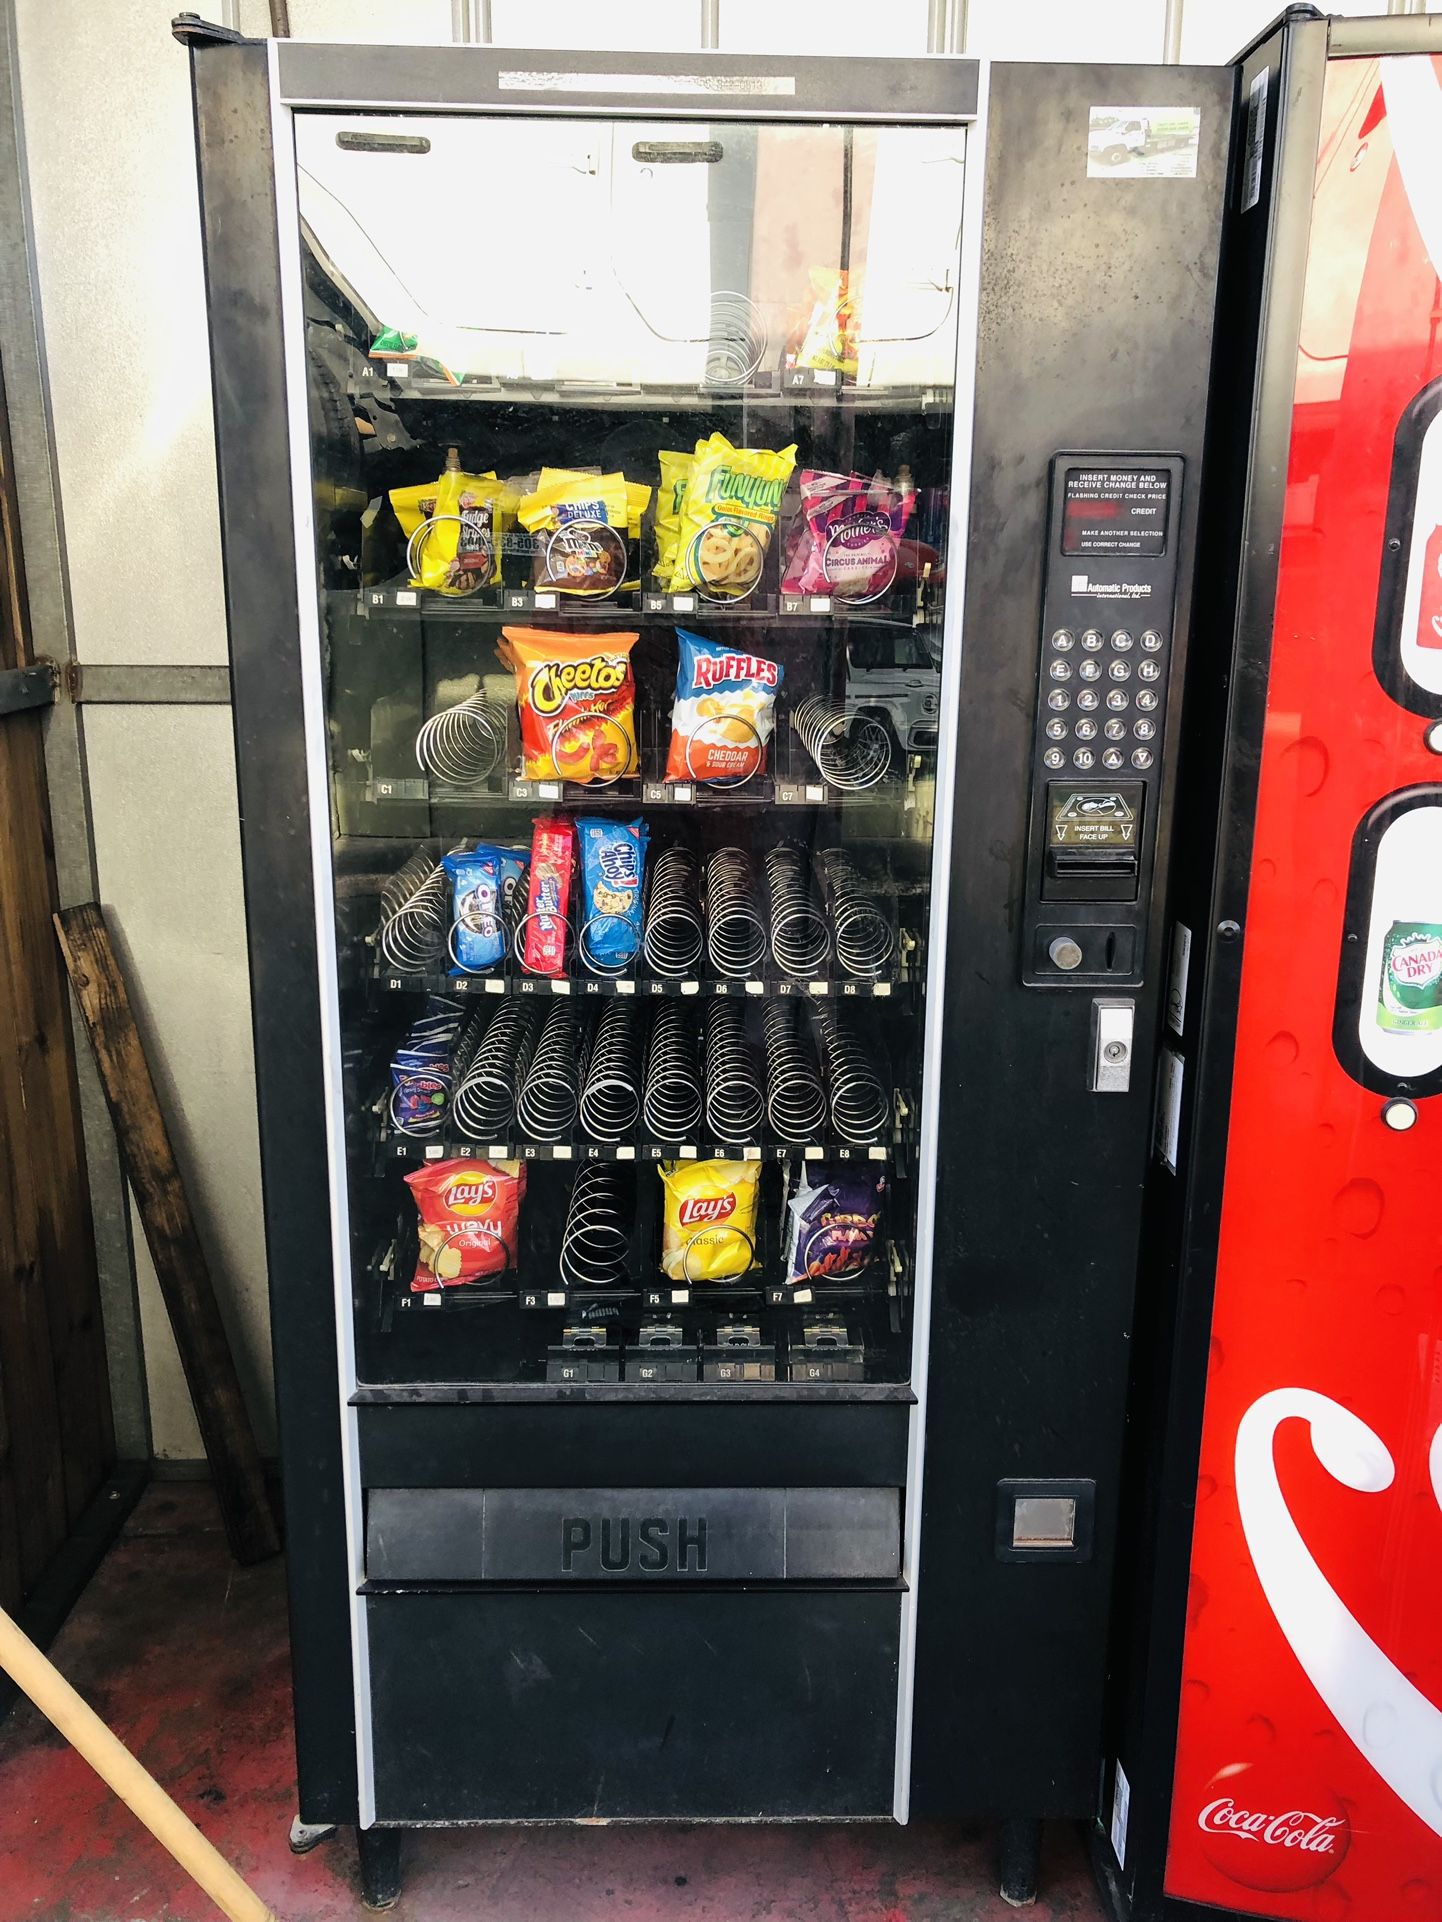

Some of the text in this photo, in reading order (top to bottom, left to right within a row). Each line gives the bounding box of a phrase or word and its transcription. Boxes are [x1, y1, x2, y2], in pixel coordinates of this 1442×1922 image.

[362, 367, 374, 377] A1
[792, 376, 804, 385] A7
[567, 510, 602, 518] DELUXE
[734, 507, 757, 517] Flavored
[462, 510, 489, 527] Fudge
[825, 555, 889, 567] CIRCUS ANIMAL
[1088, 583, 1151, 592] Automatic Products
[372, 594, 384, 604] B1
[512, 597, 524, 607] B3
[650, 600, 662, 610] B5
[786, 602, 798, 612] B7
[694, 656, 778, 688] RUFFLES
[532, 657, 628, 713] Cheetos
[708, 750, 748, 762] CHEDDAR
[381, 784, 392, 794] C1
[516, 788, 528, 798] C3
[650, 789, 662, 800] C5
[782, 791, 793, 802] C7
[613, 843, 636, 878] Chips
[536, 882, 557, 930] Nuter Butter
[1407, 962, 1433, 978] DRY
[390, 979, 401, 989] D1
[456, 980, 468, 990] D2
[522, 982, 534, 992] D3
[587, 983, 598, 993] D4
[652, 984, 662, 994] D5
[716, 984, 728, 994] D6
[780, 984, 791, 994] D7
[844, 984, 856, 994] D8
[397, 1146, 406, 1156] E1
[460, 1147, 470, 1157] E2
[526, 1148, 536, 1158] E3
[588, 1148, 598, 1158] E4
[652, 1148, 662, 1158] E5
[714, 1148, 724, 1158] E6
[776, 1148, 786, 1158] E7
[840, 1148, 850, 1158] E8
[448, 1180, 494, 1206] Lay's
[682, 1196, 733, 1224] Lay's
[526, 1296, 536, 1306] F3
[650, 1294, 660, 1304] F5
[773, 1292, 782, 1302] F7
[402, 1298, 411, 1307] F1
[563, 1368, 574, 1378] G1
[642, 1368, 653, 1378] G2
[720, 1368, 731, 1378] G3
[809, 1368, 820, 1378] G4
[560, 1517, 709, 1572] PUSH
[1198, 1798, 1346, 1853] Coca-Cola
